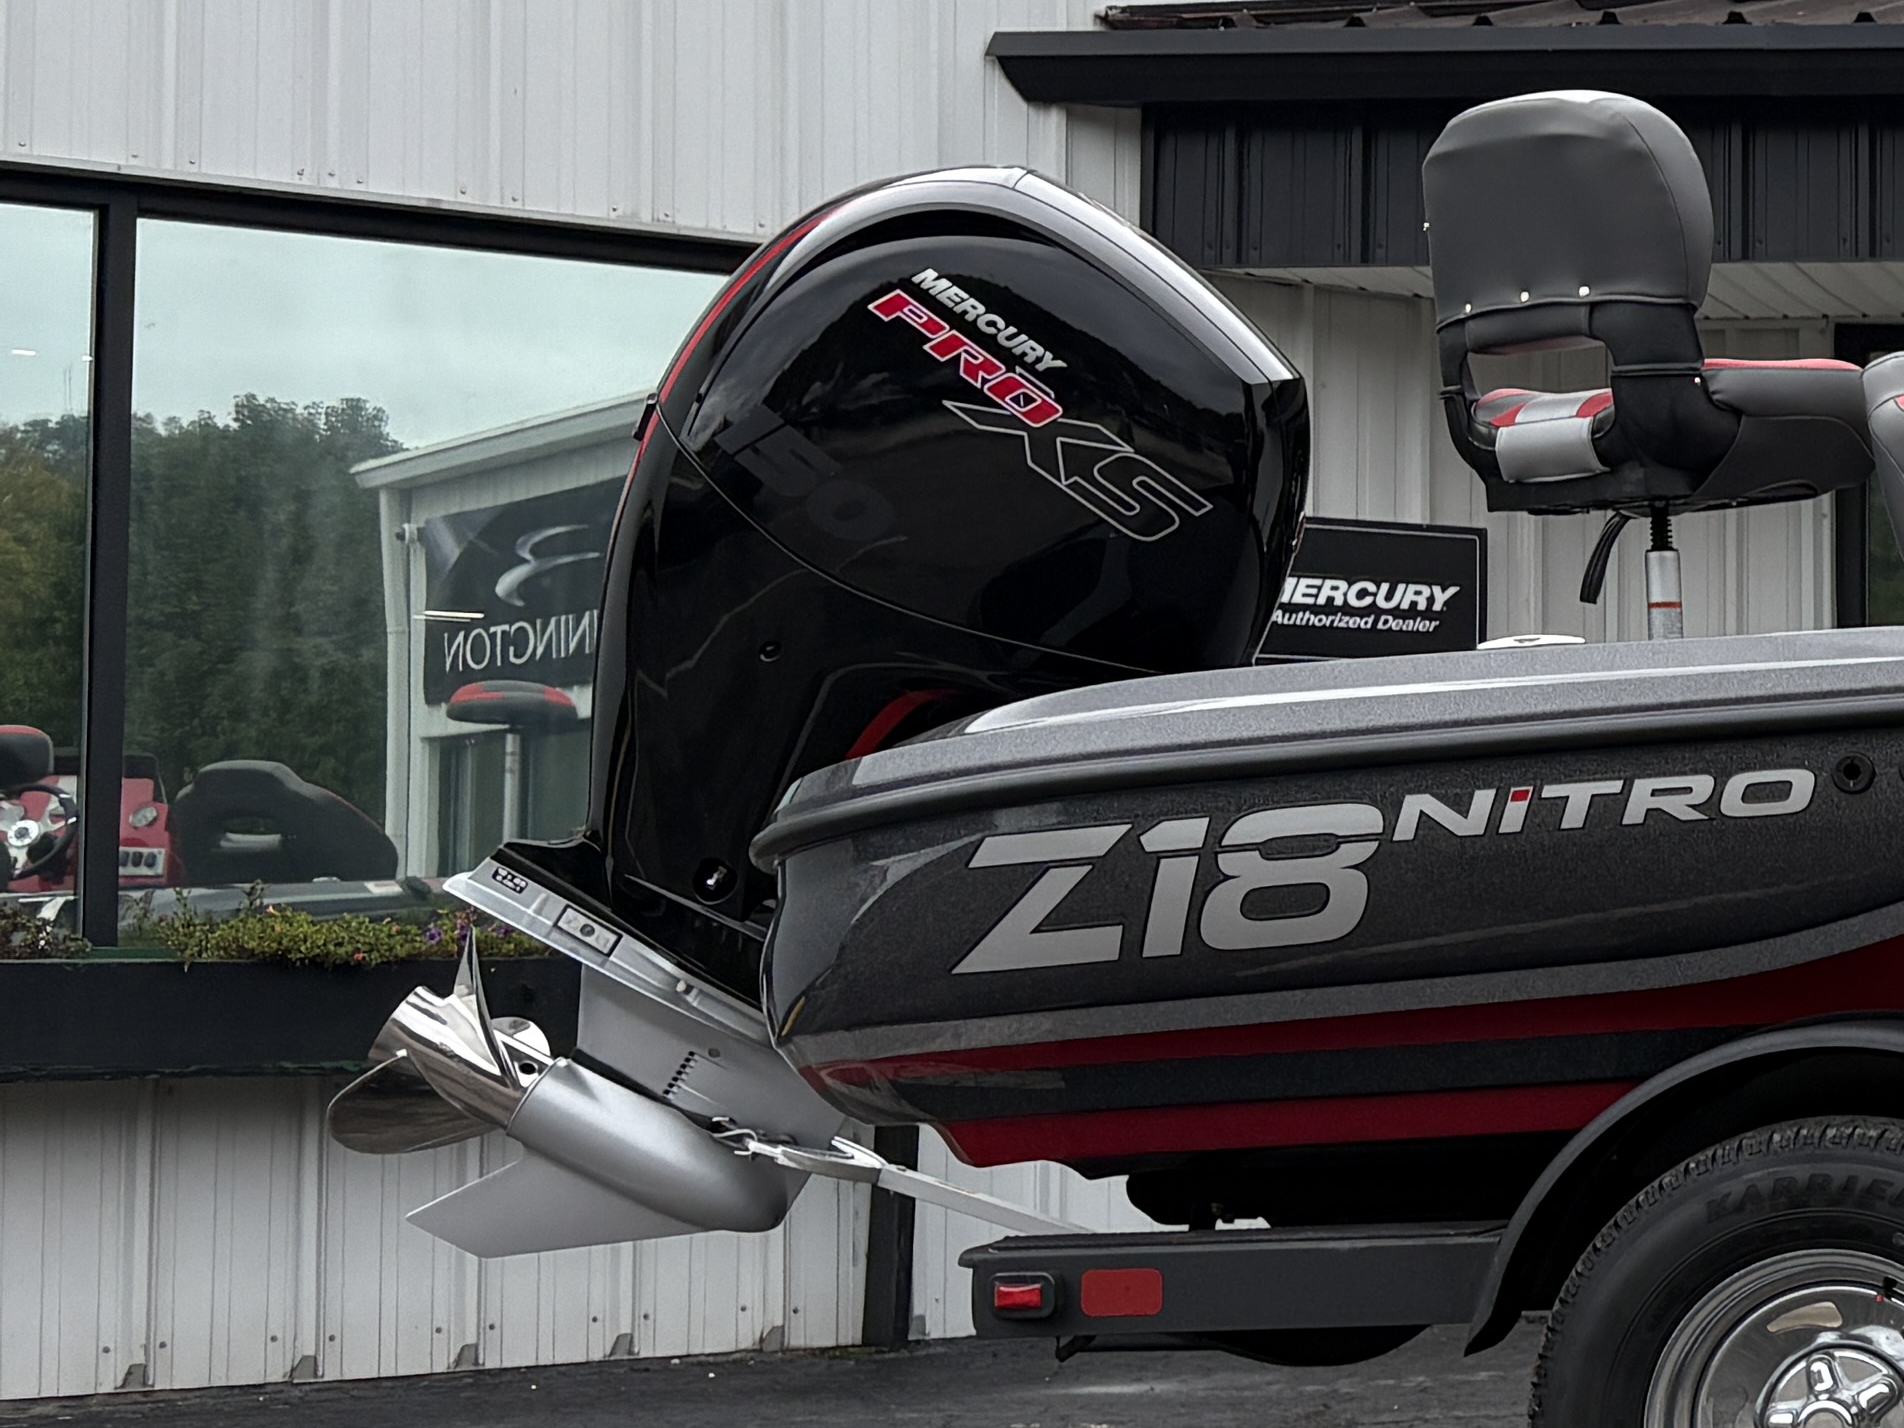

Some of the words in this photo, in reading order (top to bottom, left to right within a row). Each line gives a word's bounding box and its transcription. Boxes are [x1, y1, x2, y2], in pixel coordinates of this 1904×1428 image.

[867, 288, 1063, 428] PRO
[911, 268, 1068, 372] MERCURY
[1271, 608, 1375, 630] Authorized
[1376, 614, 1440, 633] Dealer
[951, 803, 1384, 975] Z18
